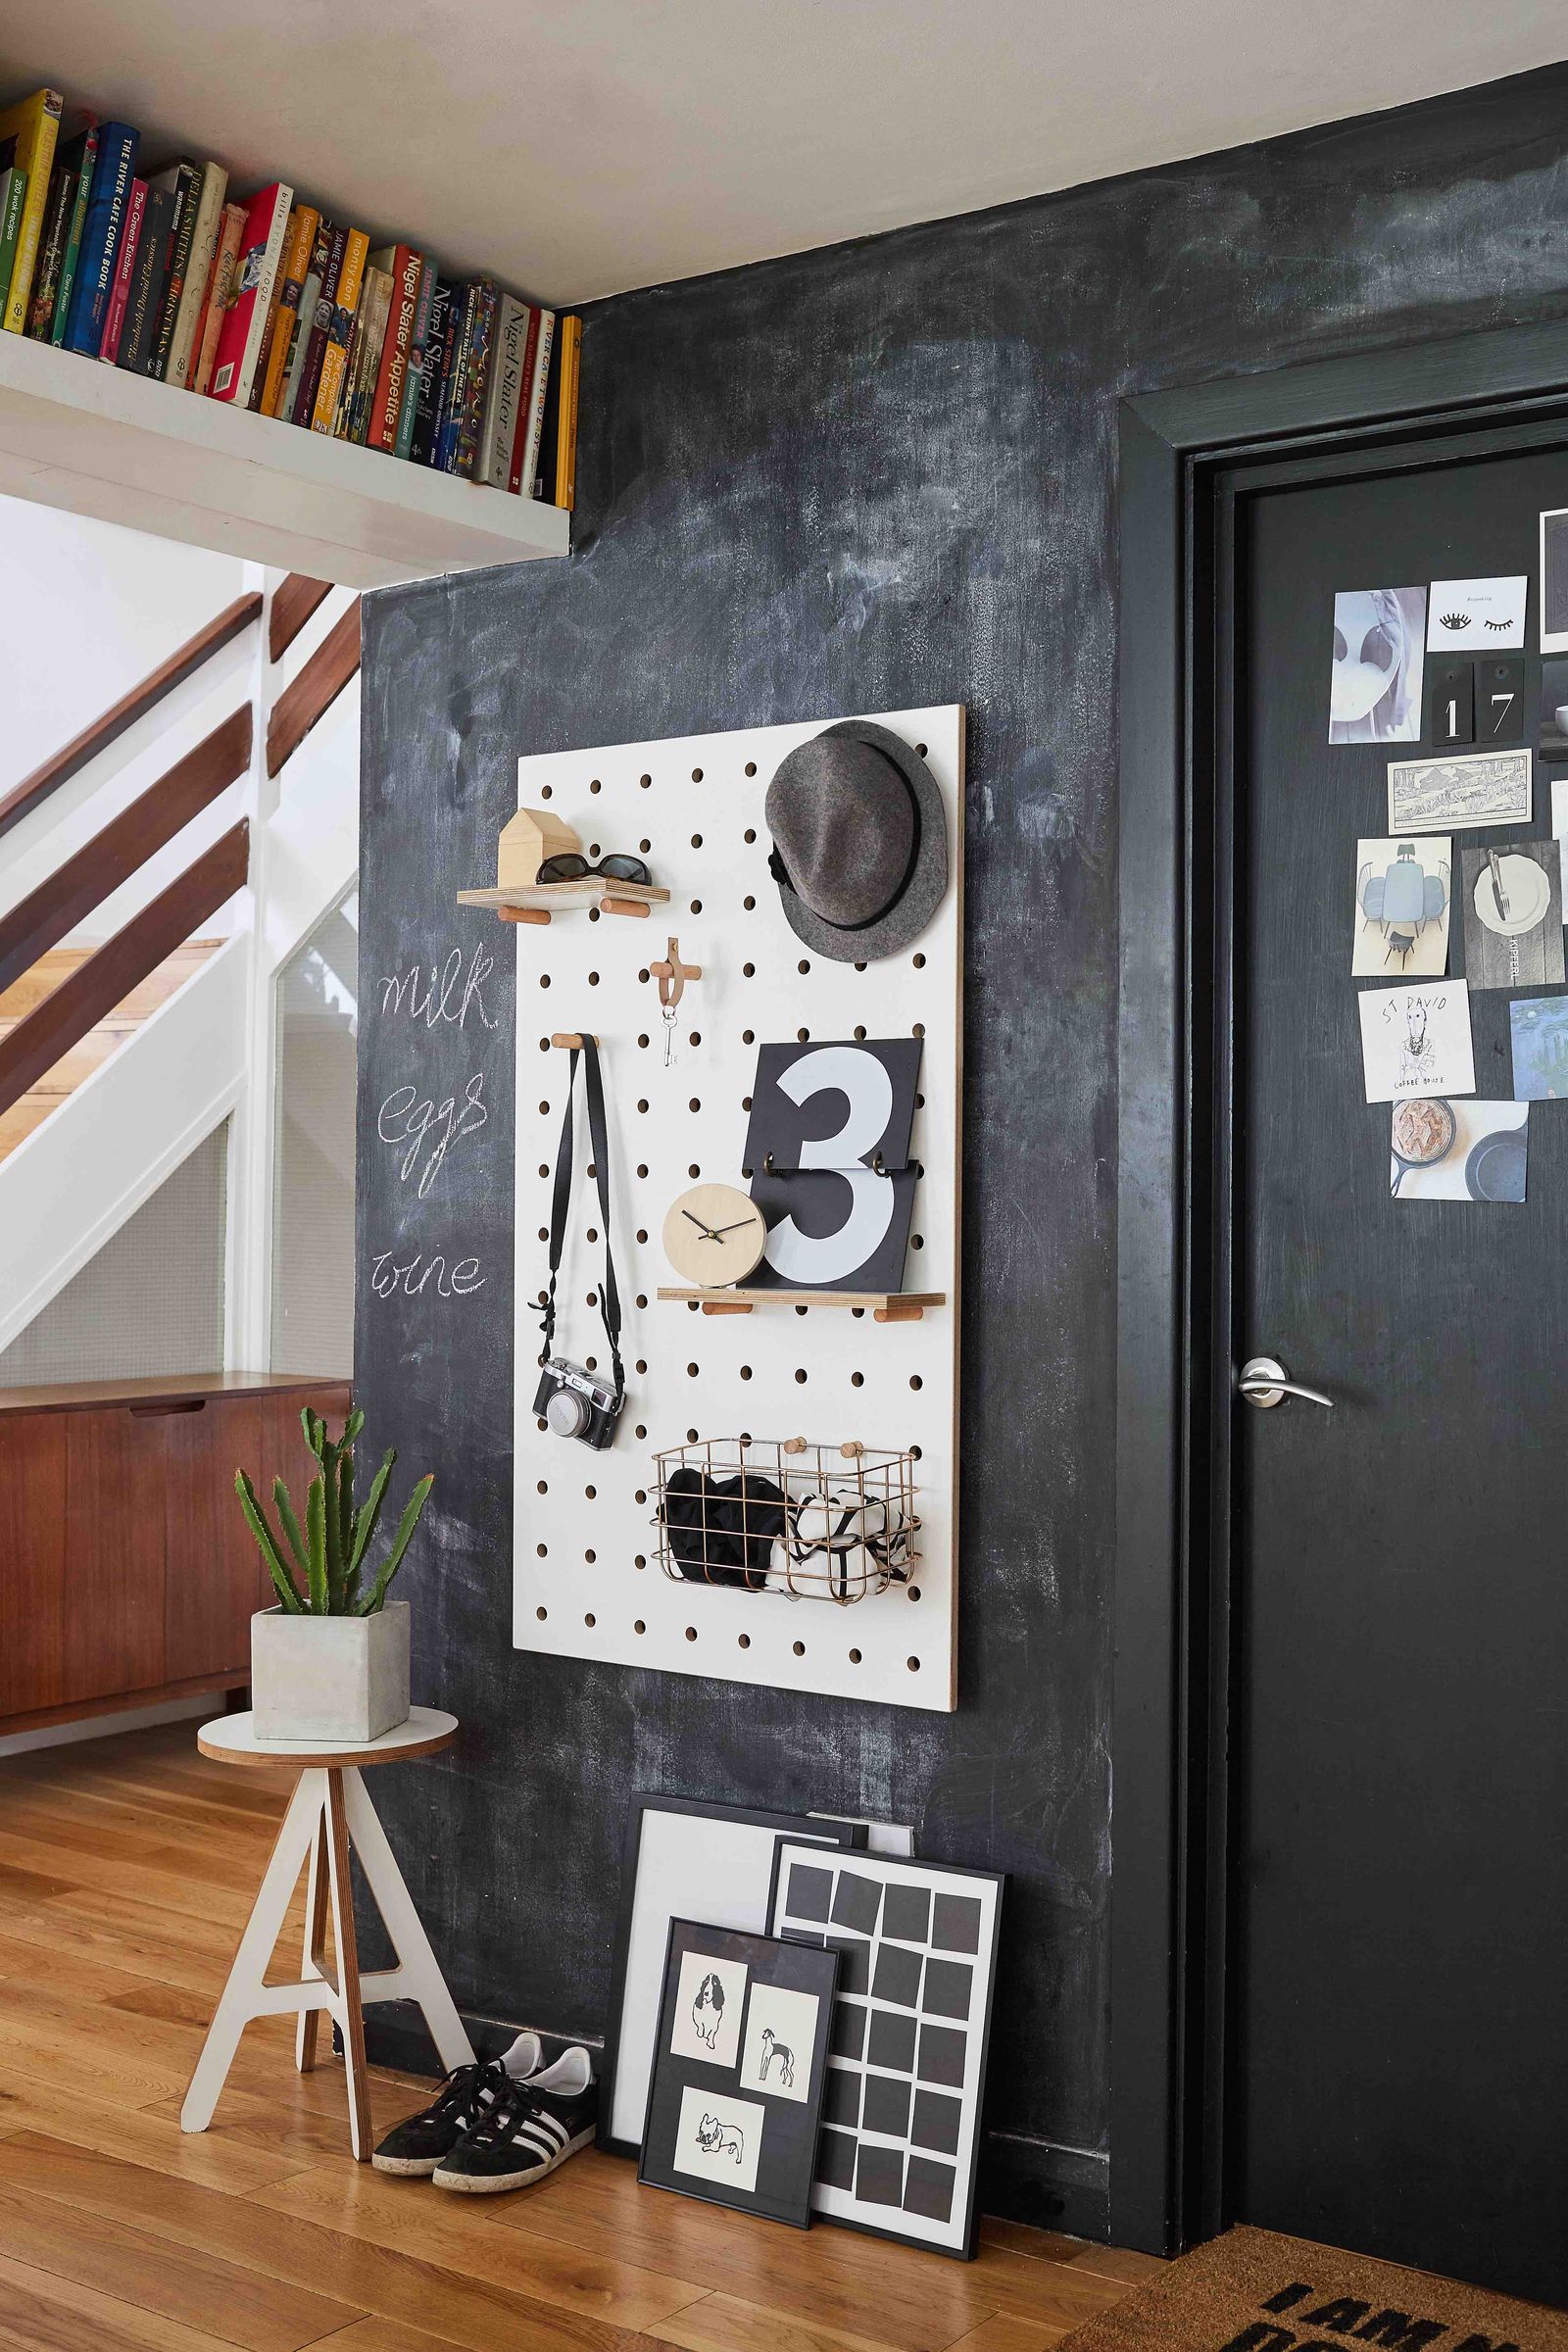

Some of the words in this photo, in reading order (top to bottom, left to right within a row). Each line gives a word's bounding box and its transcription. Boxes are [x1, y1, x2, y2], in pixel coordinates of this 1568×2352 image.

[122, 139, 132, 160] THE
[78, 173, 90, 197] your
[116, 161, 128, 195] RIVER
[185, 171, 202, 214] DELIA
[110, 196, 122, 223] CAFE
[133, 190, 143, 211] The
[276, 191, 288, 220] bills
[7, 211, 17, 241] recipes
[51, 219, 62, 246] Vegetable
[71, 199, 86, 245] allotment
[127, 211, 140, 241] Green
[299, 212, 313, 245] Jamie
[104, 225, 117, 256] COOK
[141, 235, 157, 278] Classics
[173, 215, 193, 270] SMITH'S
[330, 229, 344, 261] JAMIE
[98, 258, 111, 290] BOOK
[121, 242, 134, 280] Kitchen
[220, 248, 235, 270] Real
[292, 245, 308, 280] Oliver
[347, 237, 363, 280] monty
[63, 273, 72, 291] Clare
[259, 270, 272, 302] FOOD
[323, 261, 338, 298] OLIVER
[344, 278, 355, 302] don
[400, 253, 420, 299] Nigel
[420, 266, 433, 300] JAMIE
[59, 290, 69, 313] Foster
[135, 277, 150, 310] David
[159, 271, 183, 356] CHRISTMAS
[395, 299, 415, 352] Slater
[416, 301, 427, 339] OLIVER
[429, 285, 451, 339] Nigel
[464, 307, 472, 337] STEIN'S
[126, 308, 145, 362] Elizabeth
[501, 305, 523, 366] Nigel
[334, 355, 344, 370] The
[420, 340, 443, 398] Slater
[441, 347, 451, 377] STEIN'S
[460, 361, 466, 372] OF
[317, 349, 337, 411] Gardener
[326, 371, 341, 415] Complete
[383, 349, 406, 426] Appetite
[405, 374, 417, 407] jamie's
[498, 364, 517, 431] Slater
[401, 407, 413, 441] dinners
[1446, 700, 1460, 737] 1
[1490, 694, 1515, 734] 7
[1509, 939, 1519, 980] KIPFERL
[377, 942, 498, 1028] milk
[1382, 1000, 1397, 1024] ST
[1407, 997, 1446, 1009] DAVID
[1394, 1077, 1419, 1090] COFFEE
[378, 1072, 488, 1200] eggs
[764, 1047, 895, 1284] 3
[371, 1252, 488, 1298] wine
[1260, 2281, 1315, 2314] I
[1298, 2297, 1450, 2352] AM
